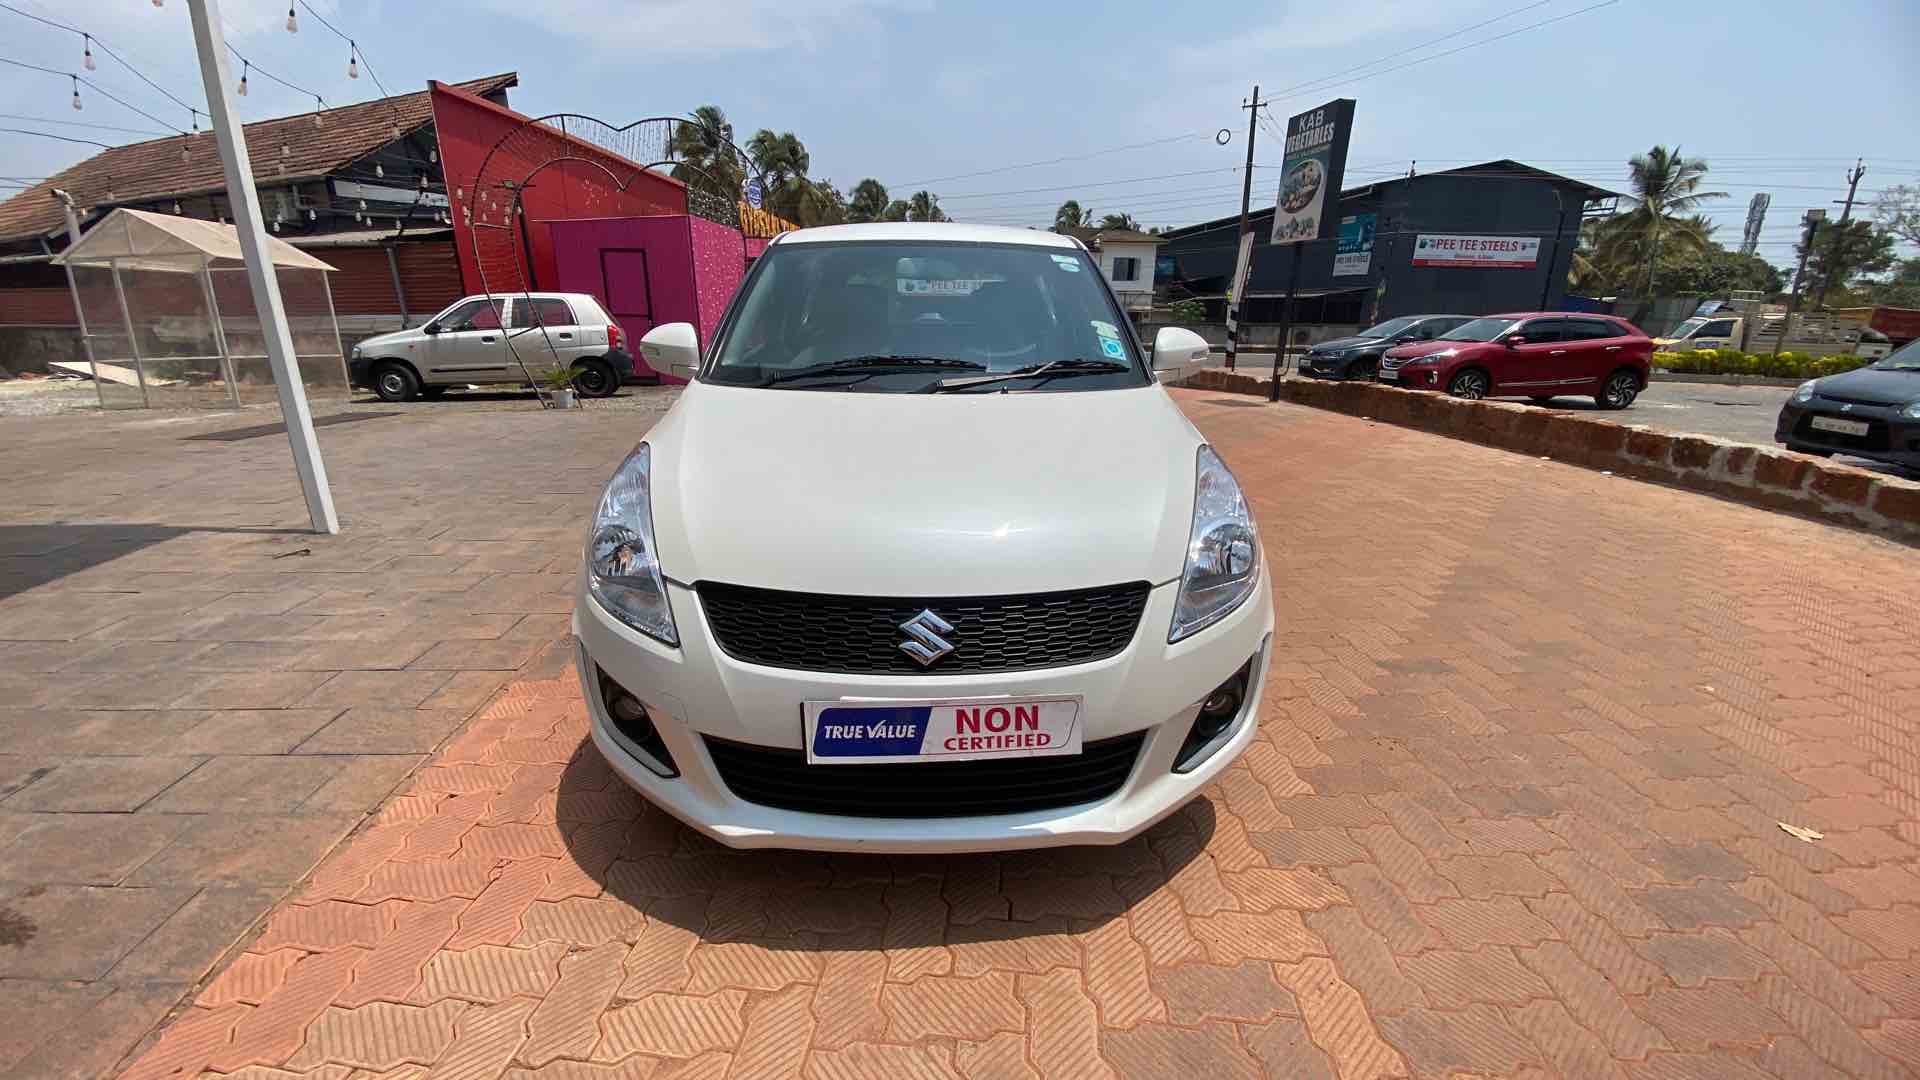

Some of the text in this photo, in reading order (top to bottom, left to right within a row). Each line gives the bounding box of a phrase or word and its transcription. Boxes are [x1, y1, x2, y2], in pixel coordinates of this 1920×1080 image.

[1299, 110, 1325, 132] KAB
[1287, 122, 1335, 153] VEGETABLES
[1435, 239, 1456, 250] PEE
[1459, 240, 1479, 250] TEE
[1480, 240, 1519, 252] STEELS
[824, 720, 917, 739] TRUE VALUE
[956, 705, 1039, 734] NON
[944, 733, 1052, 751] CERTIFIED
